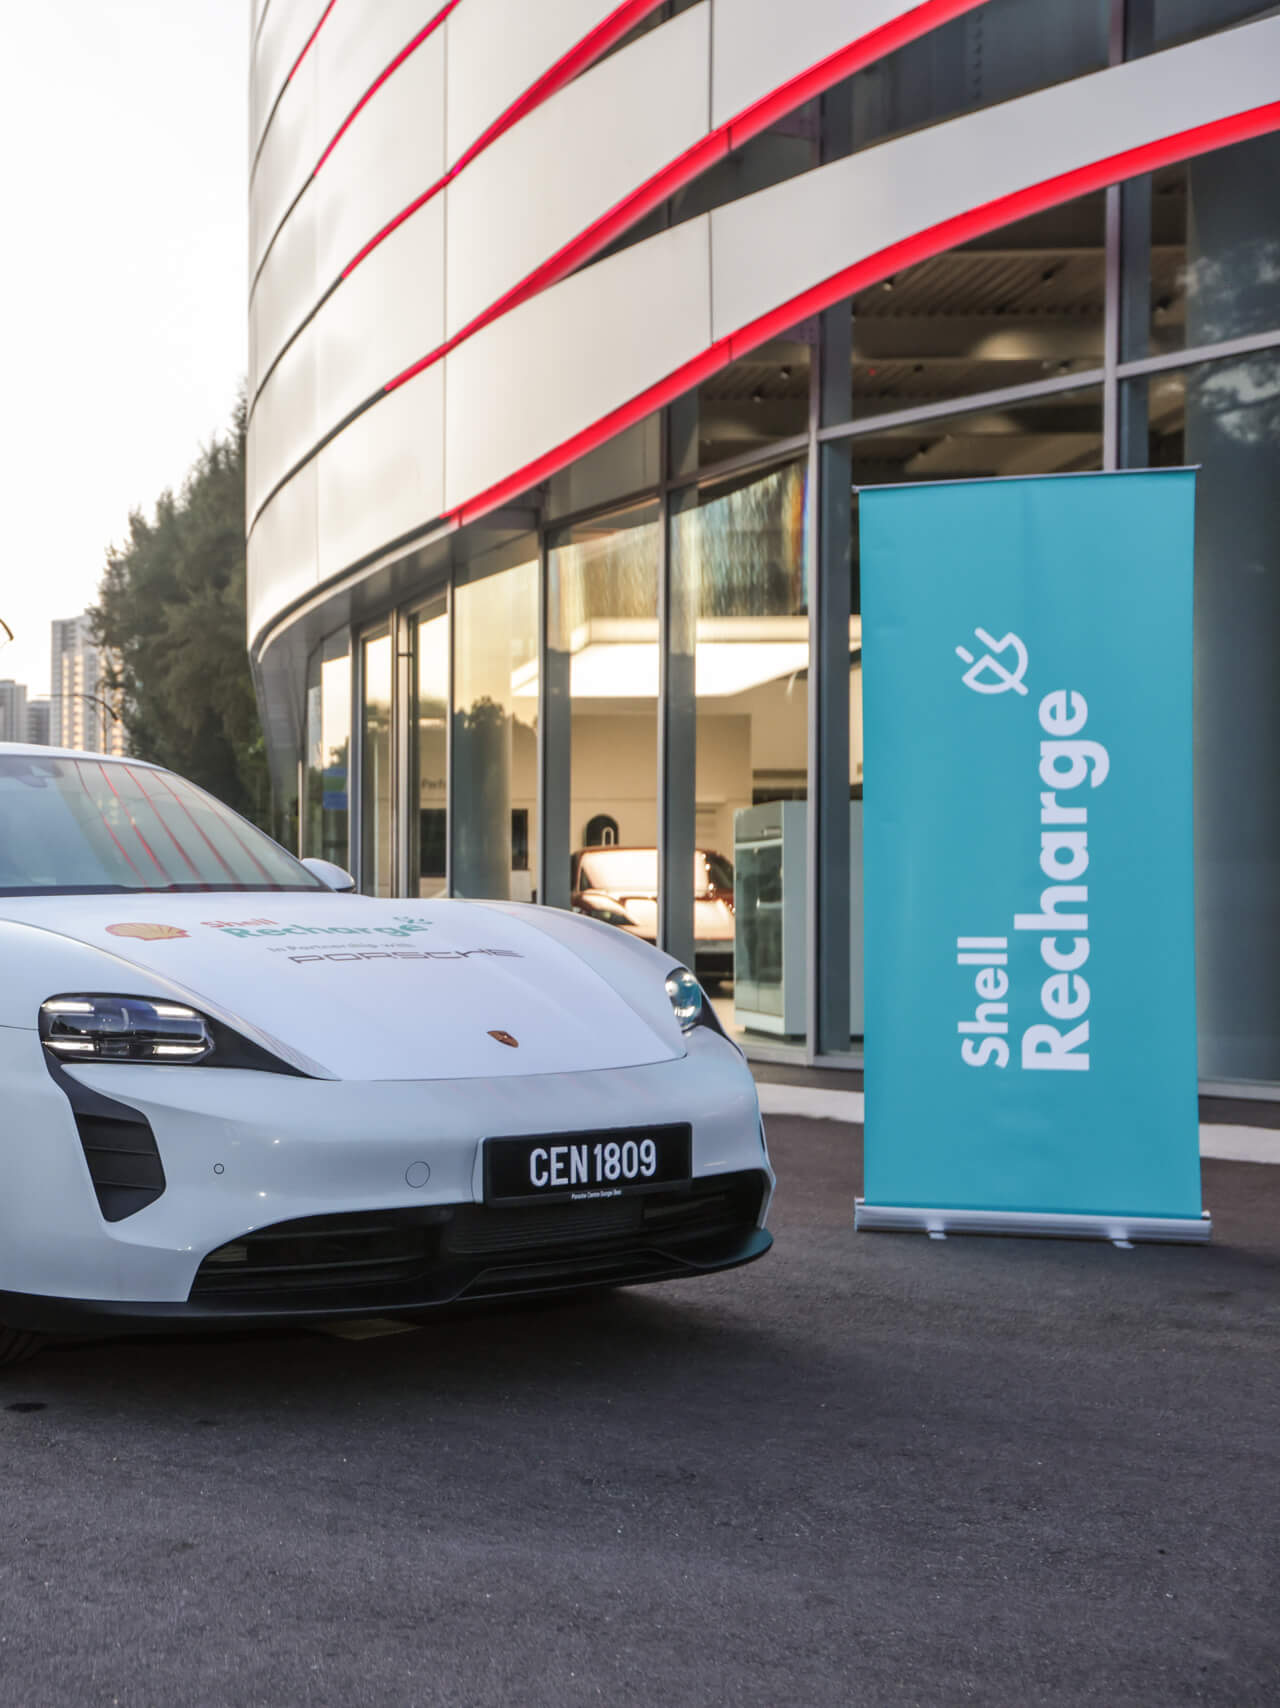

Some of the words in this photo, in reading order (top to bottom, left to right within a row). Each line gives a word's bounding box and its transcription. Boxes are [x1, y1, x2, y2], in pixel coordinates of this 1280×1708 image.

[1013, 689, 1110, 1071] Recharge
[200, 918, 280, 928] Shell
[220, 924, 428, 938] Recharge
[288, 949, 524, 964] PORSCHE
[957, 937, 1010, 1070] Shell
[529, 1145, 589, 1187] CEN
[593, 1139, 657, 1182] 1809
